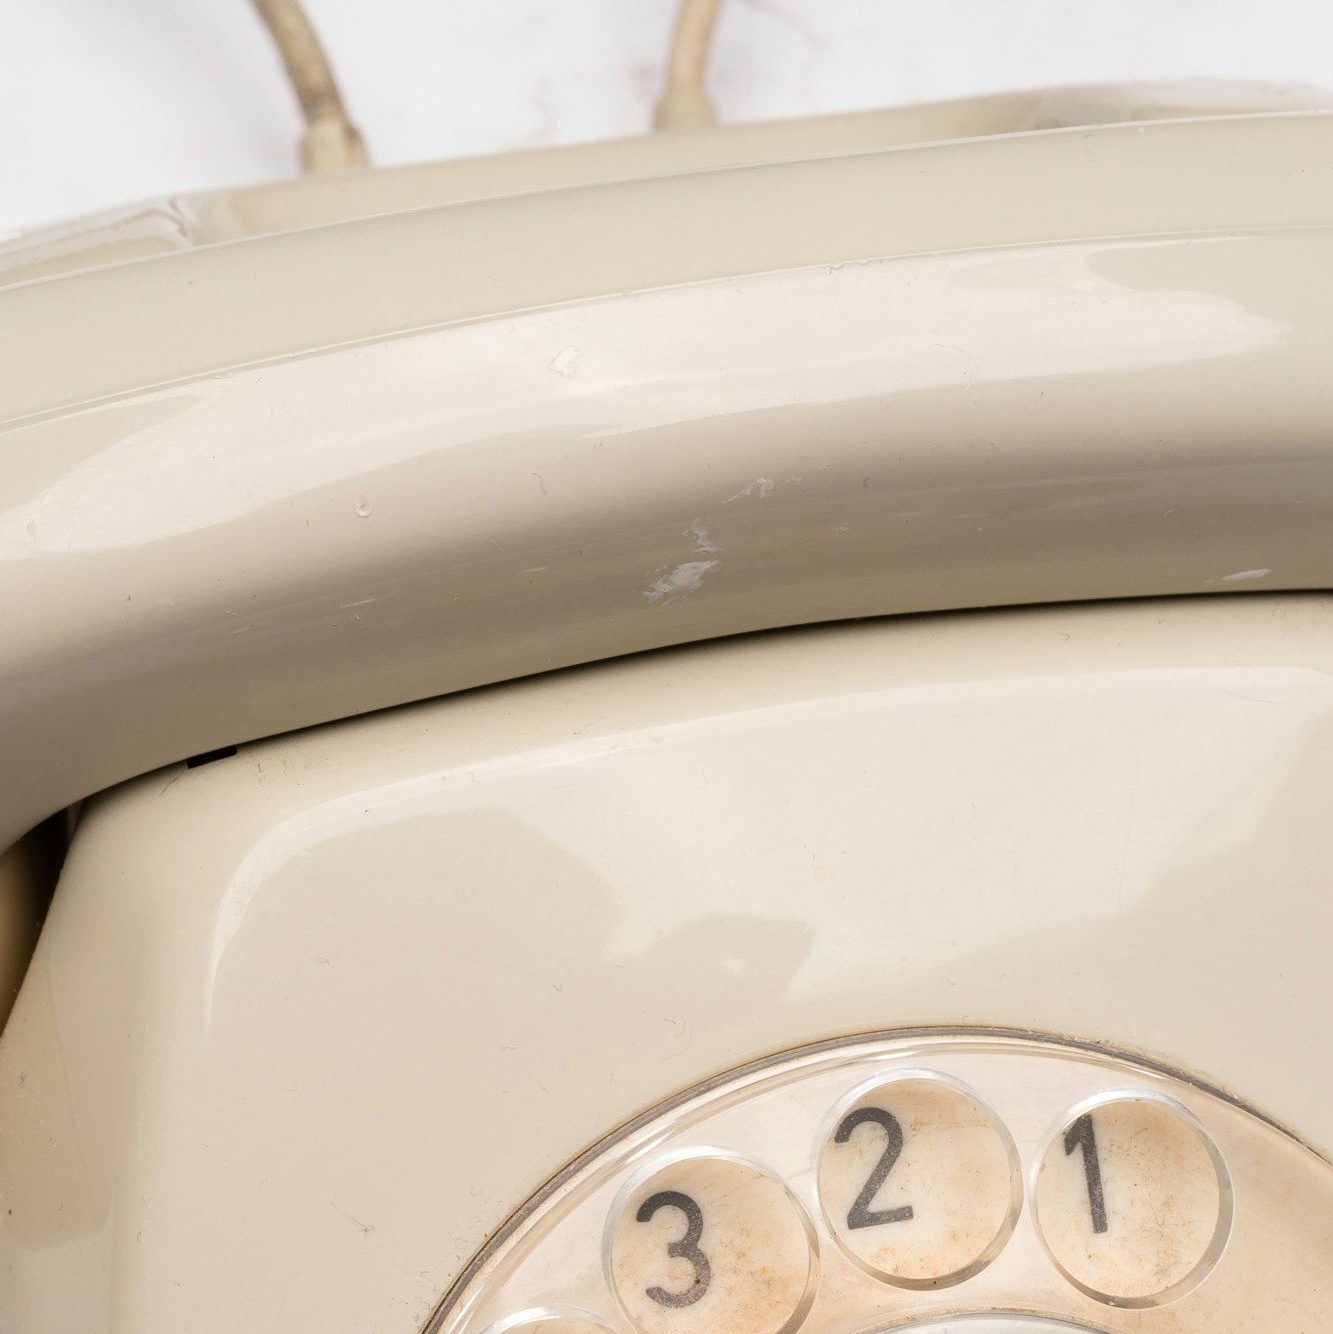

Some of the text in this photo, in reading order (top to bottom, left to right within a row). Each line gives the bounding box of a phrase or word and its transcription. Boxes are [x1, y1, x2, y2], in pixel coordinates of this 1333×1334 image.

[833, 1107, 914, 1231] 2
[1064, 1115, 1109, 1234] 1
[636, 1191, 711, 1308] 3
